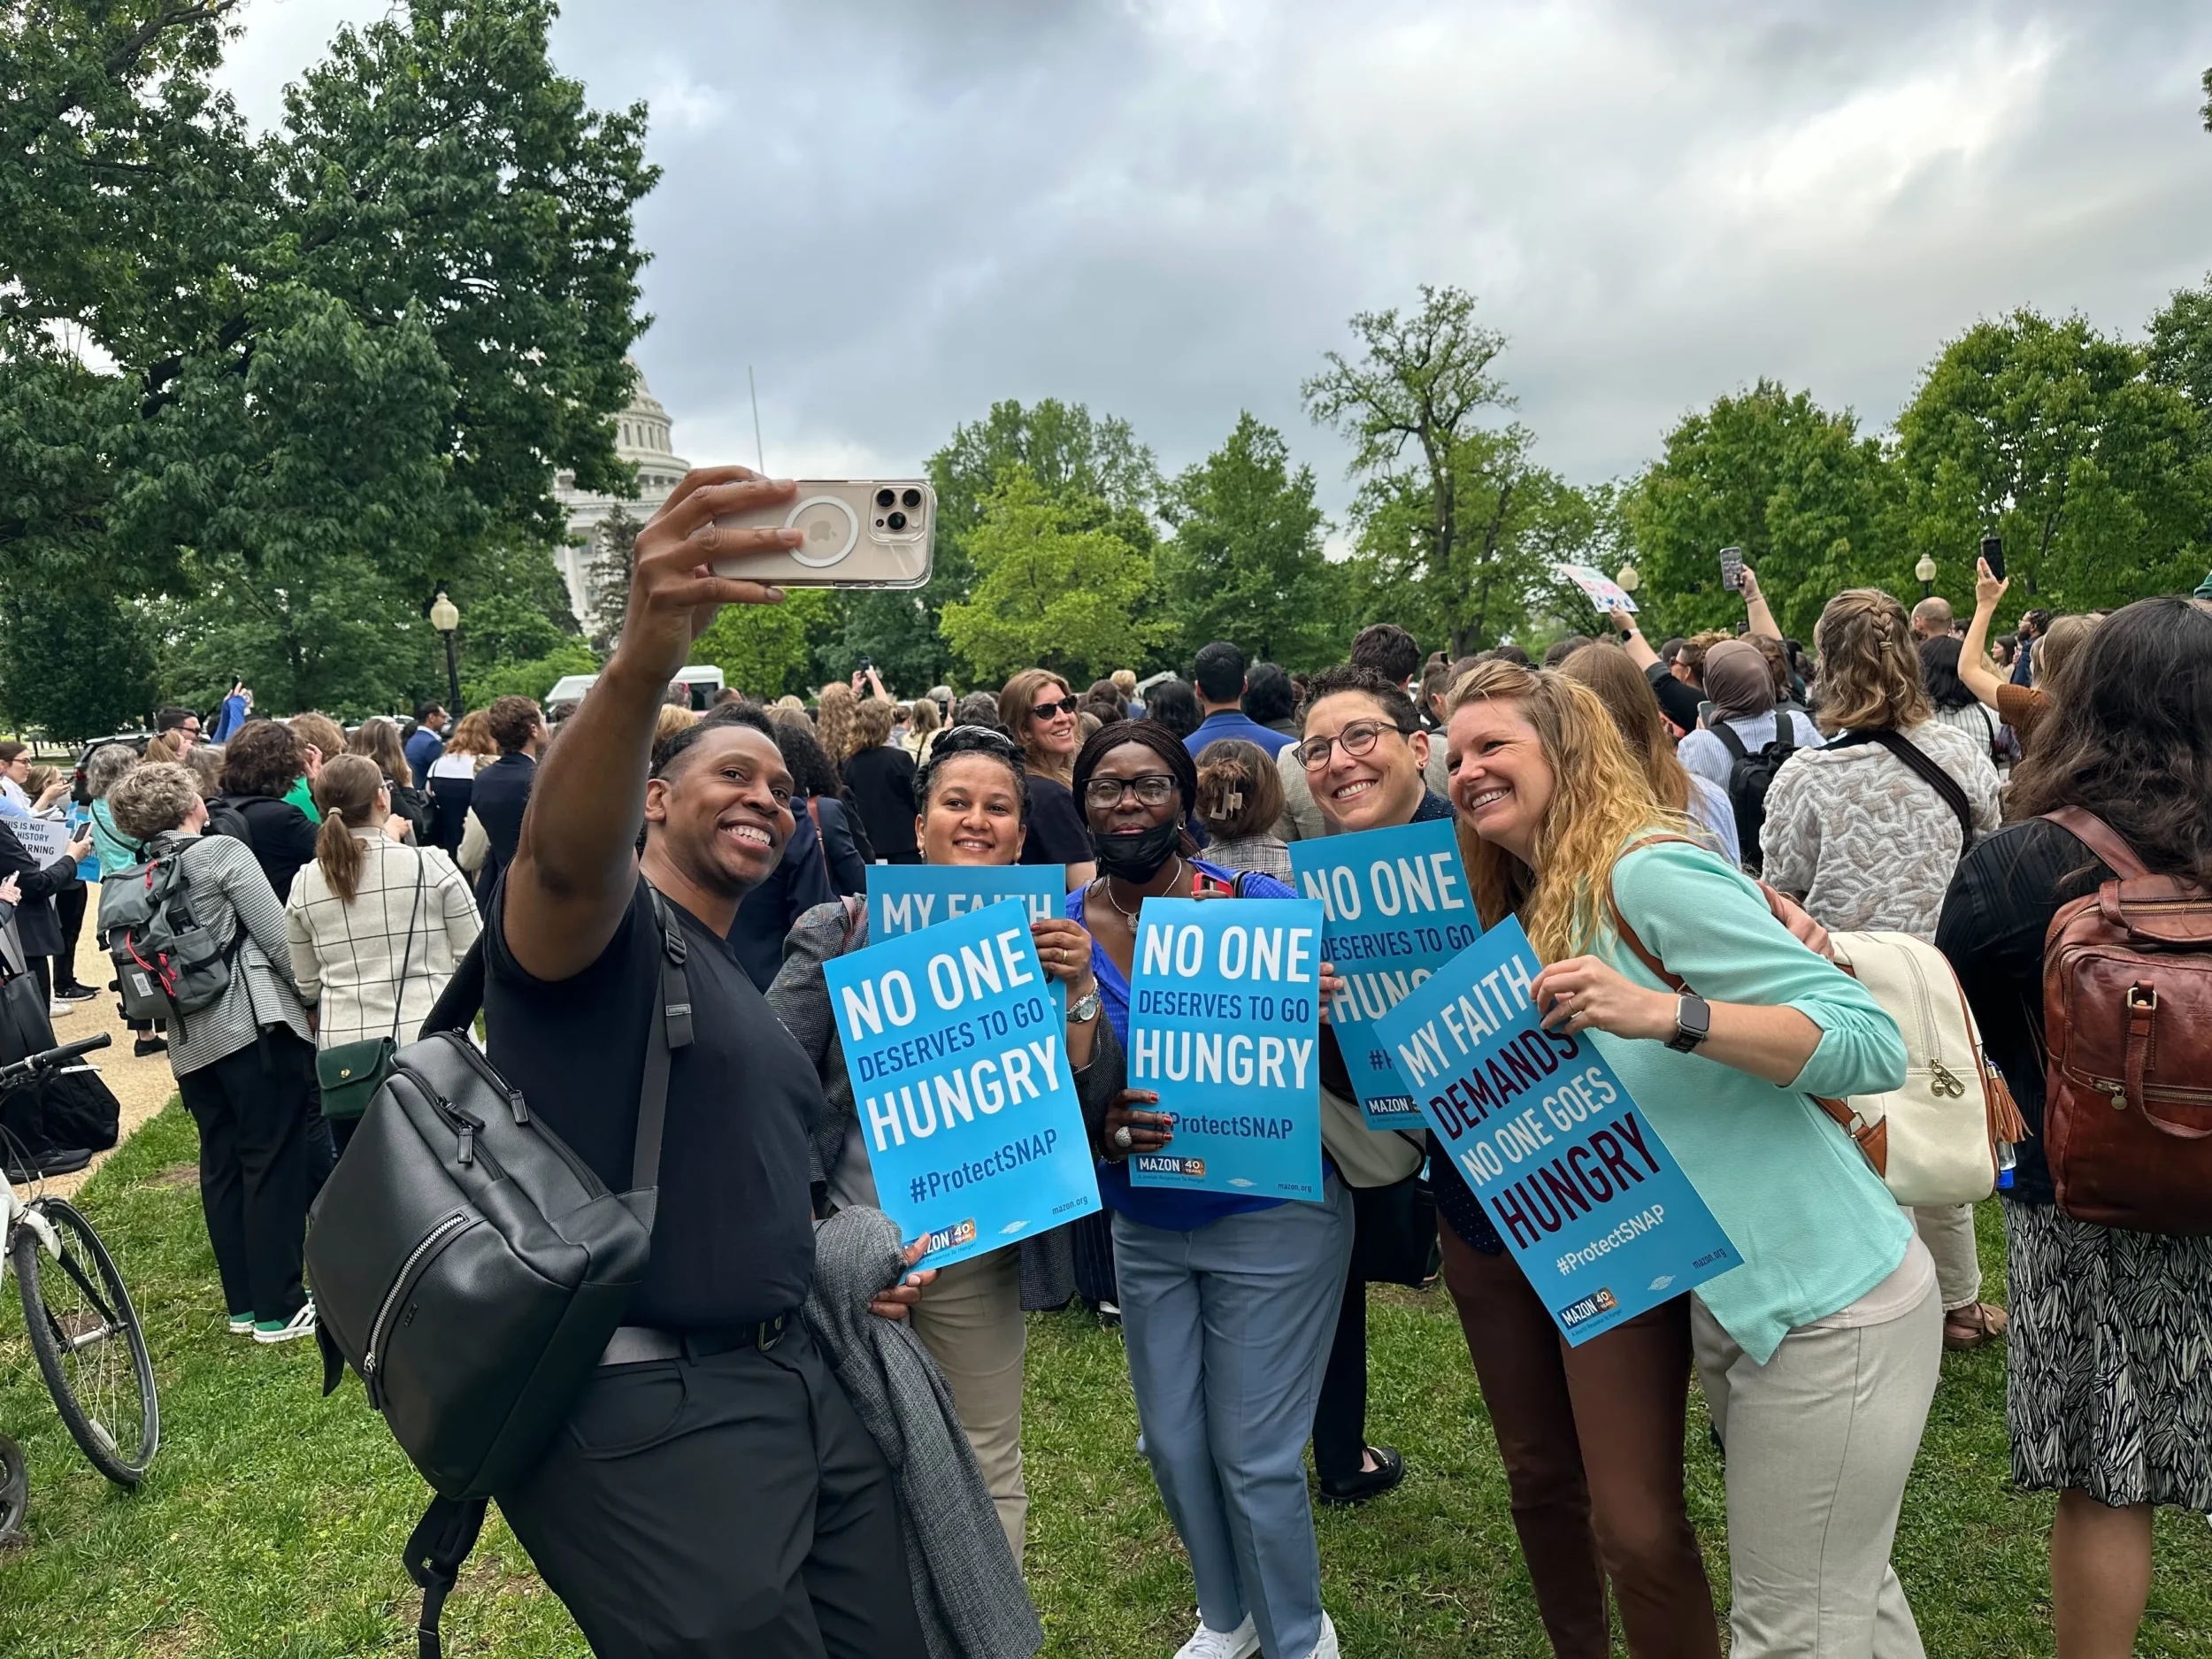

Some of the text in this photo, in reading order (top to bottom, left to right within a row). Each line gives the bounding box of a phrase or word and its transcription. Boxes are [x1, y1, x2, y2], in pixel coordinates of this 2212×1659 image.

[17, 832, 50, 841] HISTORY
[29, 823, 45, 832] NOT
[23, 843, 55, 855] ARNING
[1302, 851, 1464, 921] NO ONE
[882, 894, 935, 933] MY
[1143, 924, 1313, 982] NO ONE
[1321, 925, 1475, 961] DESERVES TO GO
[841, 928, 1033, 1041] NO ONE
[1139, 989, 1310, 1023] DESERVES TO GO
[1398, 954, 1532, 1088] MY FAITH
[857, 997, 1045, 1082] DESERVES TO GO
[1135, 1028, 1313, 1089] HUNGRY
[865, 1035, 1060, 1151] HUNGRY
[1428, 1028, 1579, 1141] DEMANDS
[1369, 1098, 1409, 1113] MAZON
[1460, 1066, 1617, 1187] NO ONE GOES
[910, 1128, 1056, 1203] #ProtectSNAP
[1140, 1157, 1200, 1171] MAZON 40
[1491, 1111, 1660, 1250] HUNGRY
[1052, 1196, 1087, 1215] mazon.org
[1278, 1183, 1311, 1193] mazon.org
[954, 1223, 971, 1236] 40
[1556, 1204, 1665, 1276] #ProtectSNAP
[1692, 1248, 1727, 1269] mazon.org
[1562, 1291, 1609, 1325] MAZON 40
